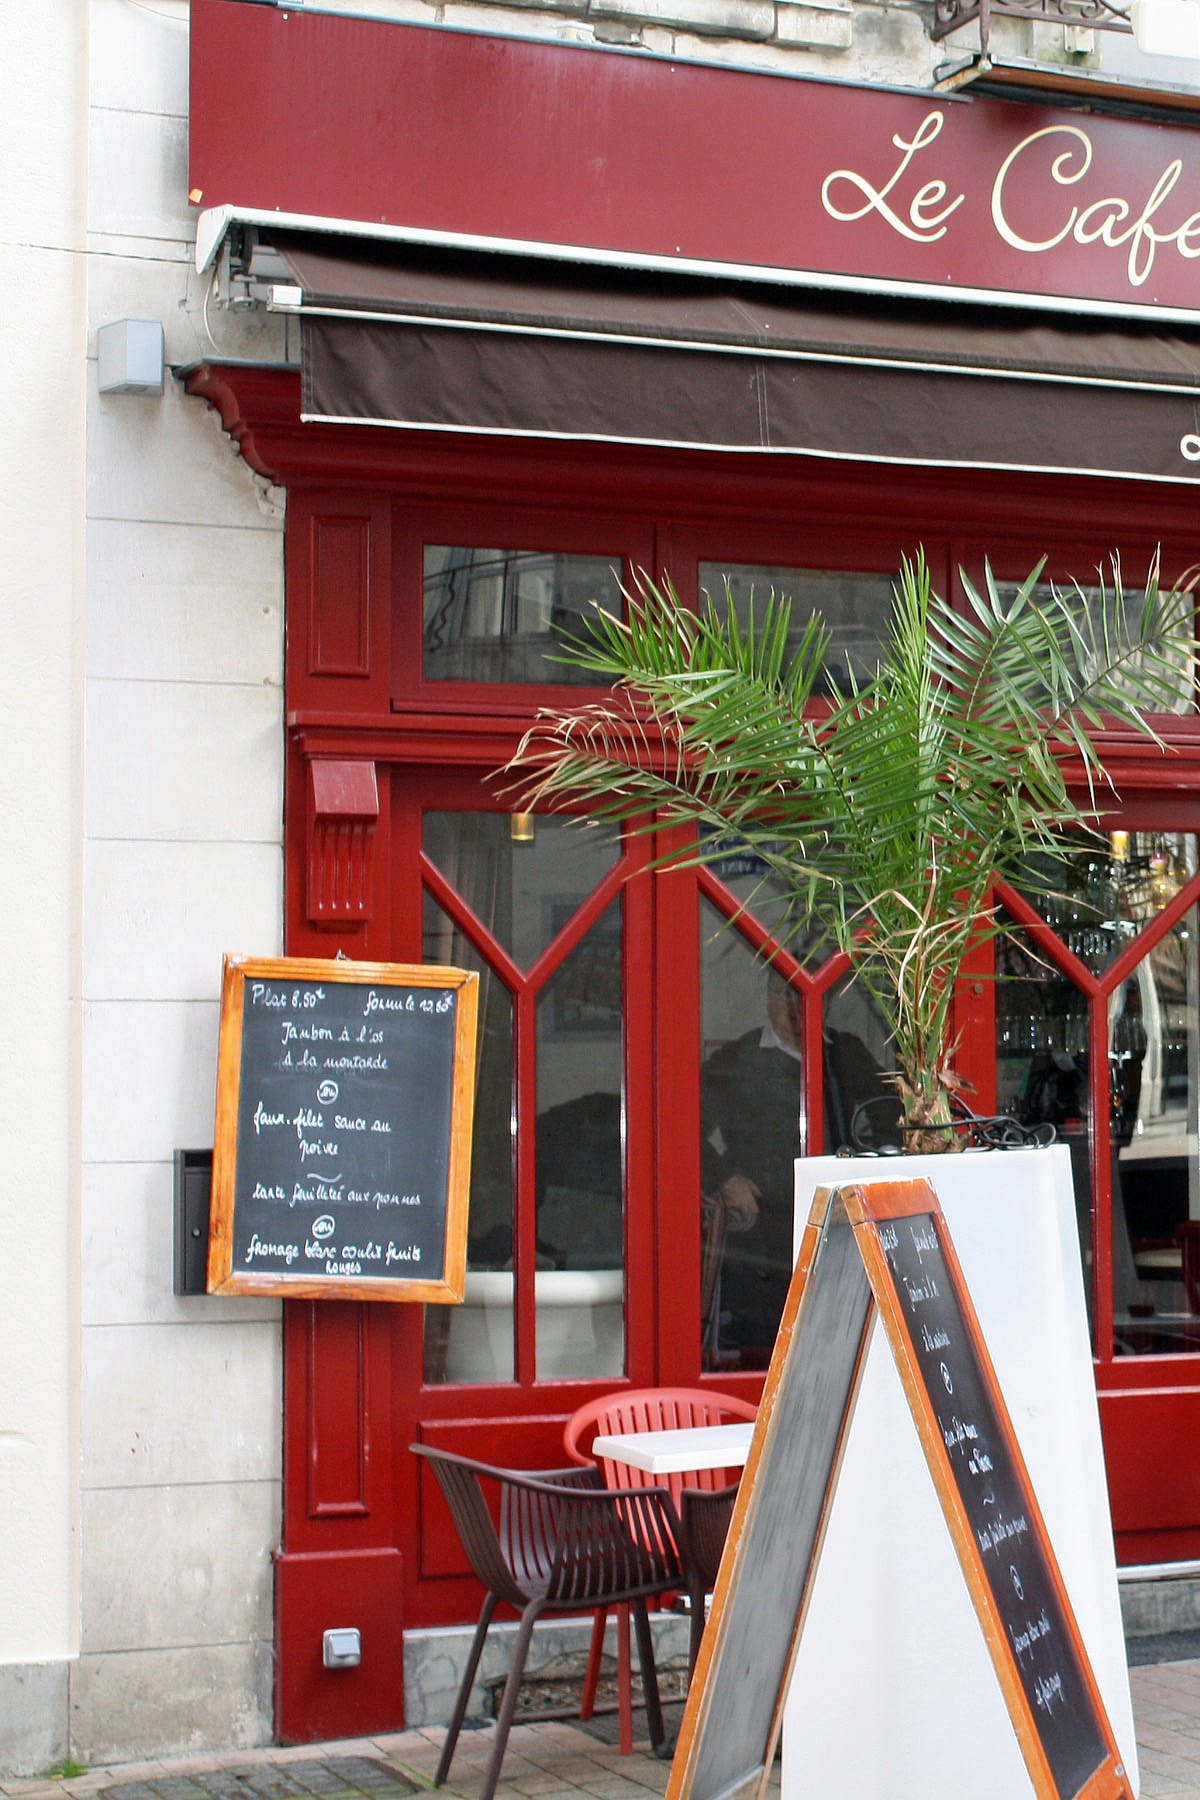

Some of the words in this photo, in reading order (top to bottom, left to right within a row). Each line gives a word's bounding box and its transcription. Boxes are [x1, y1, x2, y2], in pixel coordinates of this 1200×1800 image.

[820, 110, 965, 243] Le
[252, 984, 287, 1007] Plat
[363, 990, 414, 1016] formule
[338, 1026, 350, 1042] à
[296, 1049, 318, 1067] la
[323, 1053, 388, 1070] moutarde
[334, 1114, 366, 1130] sauce
[370, 1119, 391, 1133] au
[347, 1189, 371, 1202] aux
[245, 1234, 299, 1265] fromage
[384, 1241, 422, 1267] fruits
